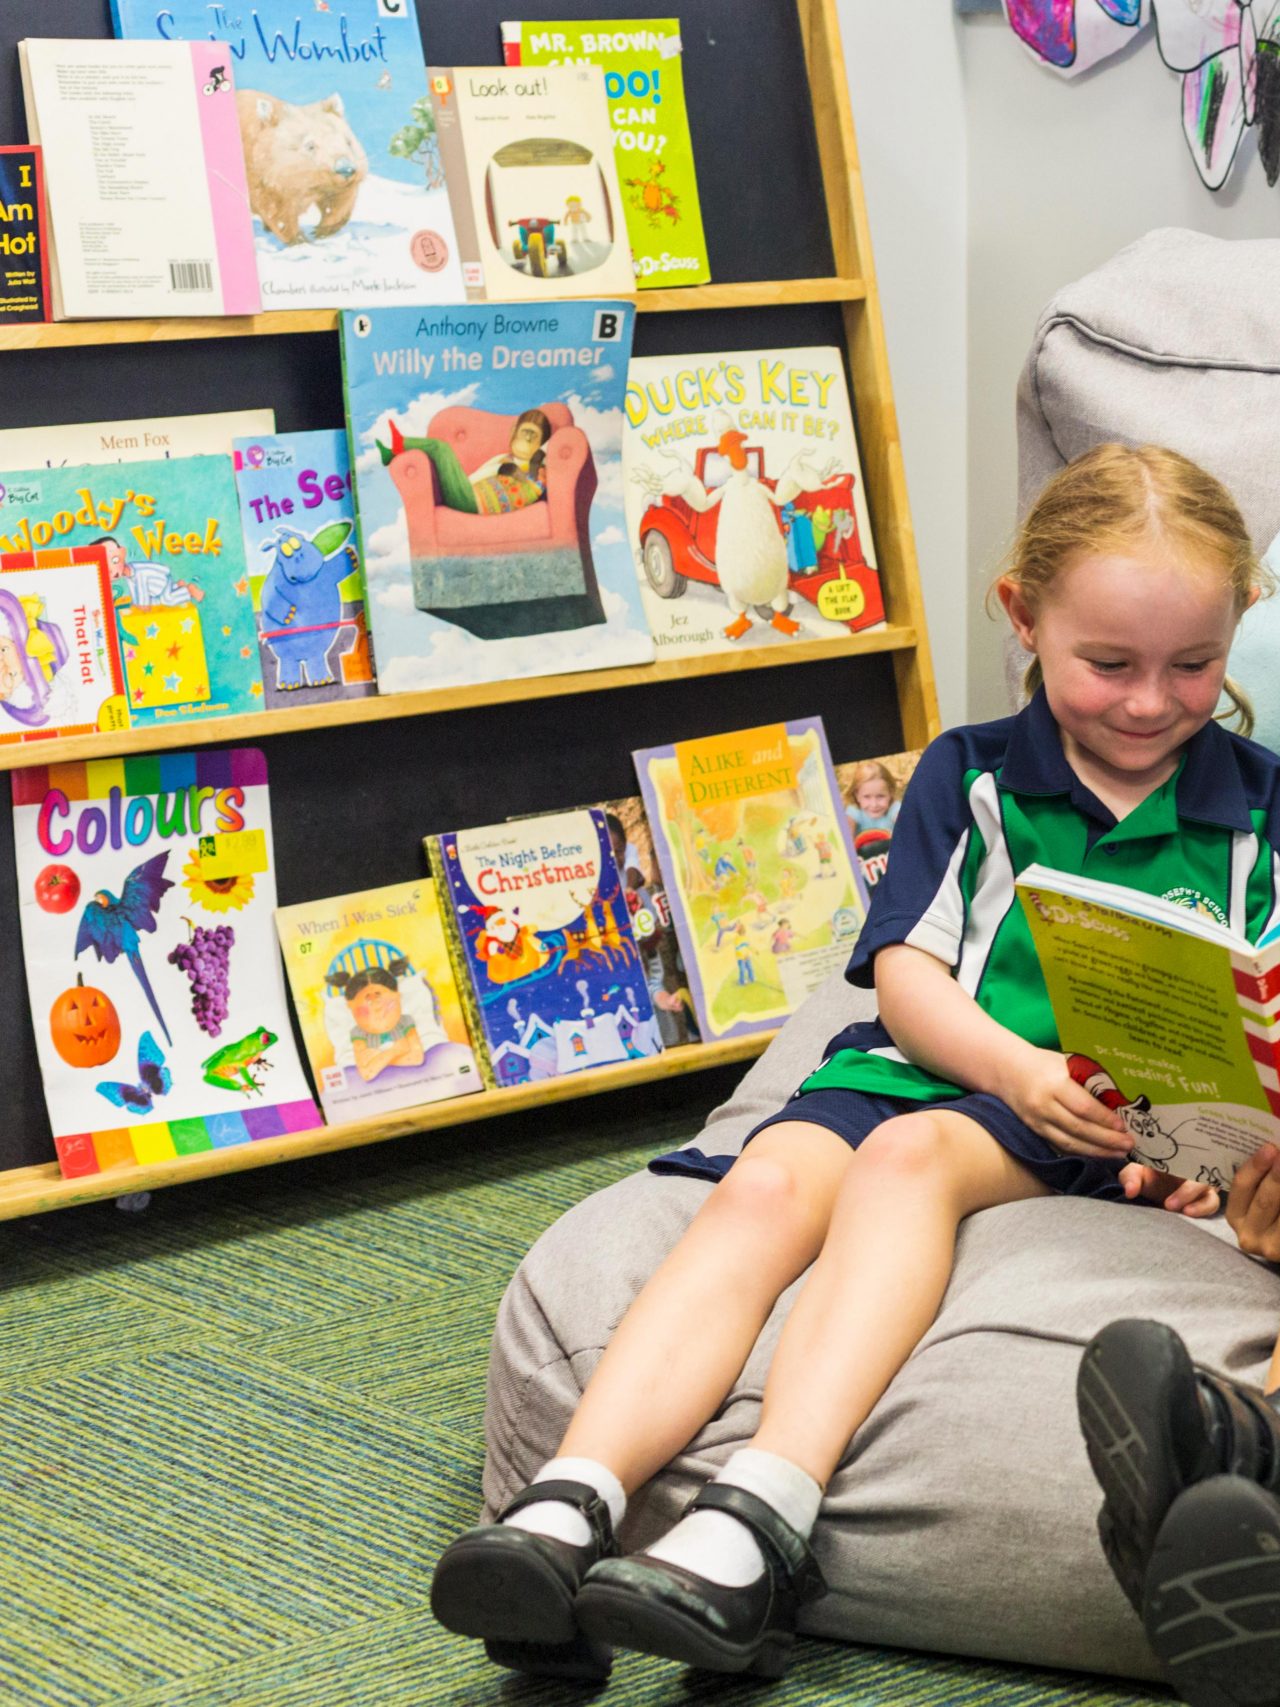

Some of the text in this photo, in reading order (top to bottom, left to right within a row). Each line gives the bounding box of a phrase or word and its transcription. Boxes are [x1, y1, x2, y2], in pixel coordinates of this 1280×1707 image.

[206, 3, 243, 31] The
[252, 9, 389, 64] Wombat
[529, 31, 664, 54] MR. BROWN
[469, 77, 549, 97] Look out!
[604, 69, 662, 105] OO!
[613, 108, 656, 125] CAN
[611, 128, 667, 155] YOU?
[19, 165, 32, 188] I
[661, 252, 700, 272] Seuss
[415, 313, 560, 341] Anthony Browne
[598, 313, 618, 339] B
[372, 345, 605, 380] Willy the Dreamer
[624, 358, 838, 429] DUCK'S KEY
[100, 432, 170, 451] Mem Fox
[641, 409, 840, 449] WHERE CAN IT BE?
[249, 469, 352, 524] The Se
[0, 488, 156, 554] Woody's
[130, 518, 223, 560] Week
[824, 595, 859, 604] THE FLAP
[670, 614, 689, 629] Jez
[73, 605, 95, 685] That Hat
[691, 739, 783, 777] ALIKE and
[689, 767, 792, 803] DIFFERENT
[37, 785, 245, 856] Colours
[476, 843, 583, 868] The Night Before
[477, 861, 596, 895] Christmas
[297, 901, 418, 936] When I Was Sick
[1161, 888, 1229, 928] OSEPH'S SCHOO
[1078, 911, 1130, 942] Seuss
[1113, 1045, 1144, 1063] Seuss
[1148, 1057, 1183, 1073] makes
[1122, 1066, 1175, 1088] reading
